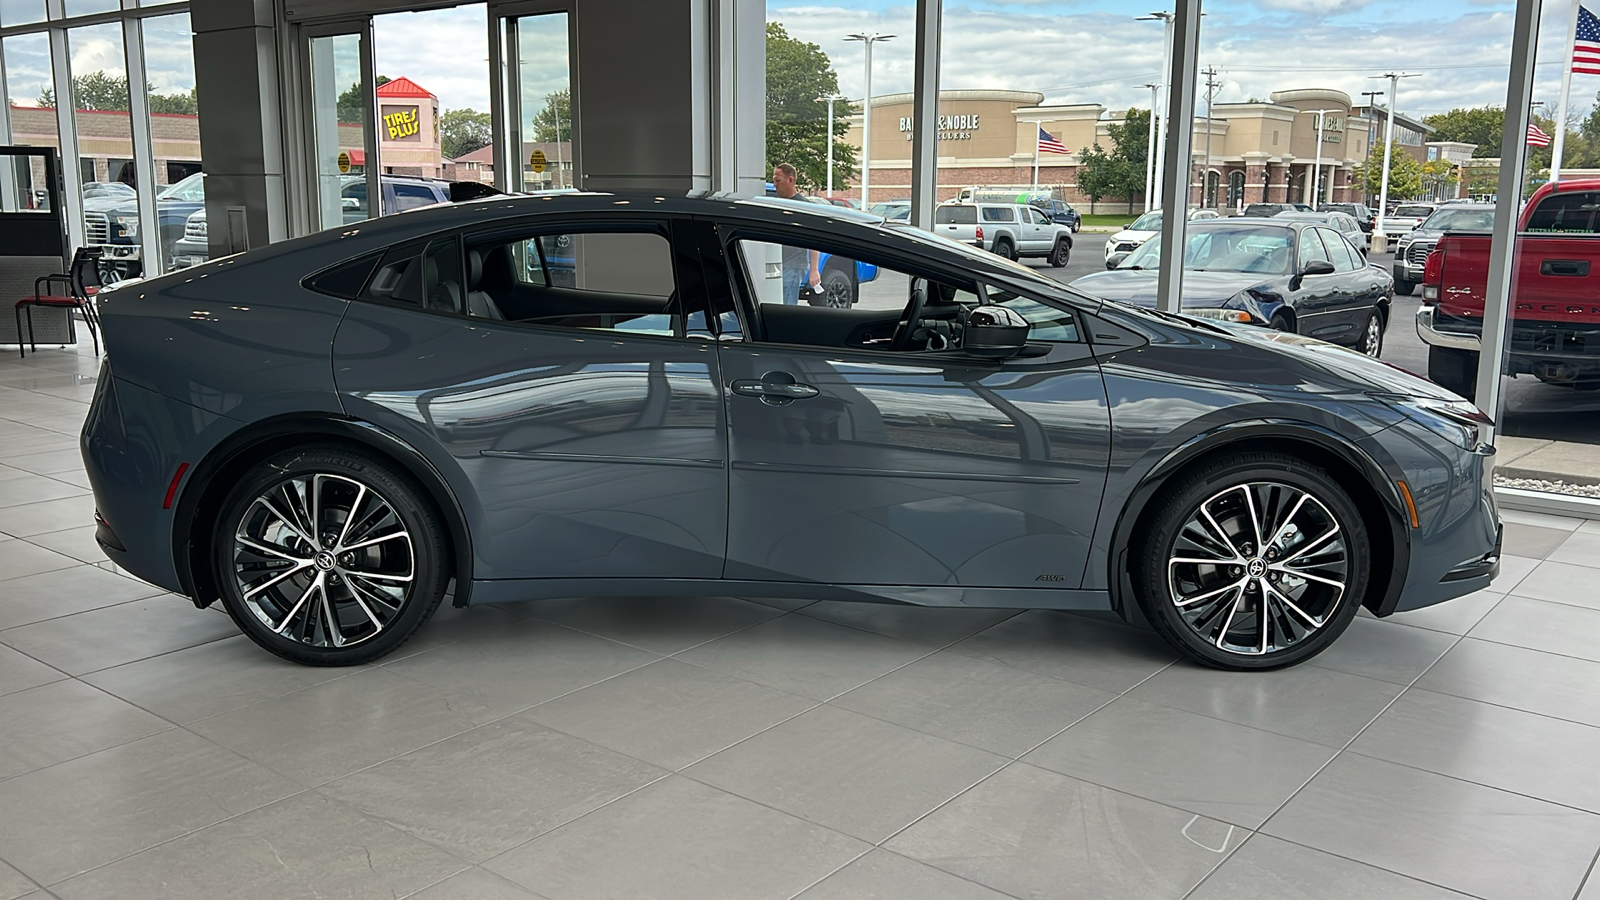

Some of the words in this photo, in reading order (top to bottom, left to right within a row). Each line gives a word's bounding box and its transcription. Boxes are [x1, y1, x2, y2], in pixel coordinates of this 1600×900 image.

[383, 108, 417, 127] TIRES
[388, 120, 419, 140] PLUS
[1034, 574, 1066, 582] AWD
